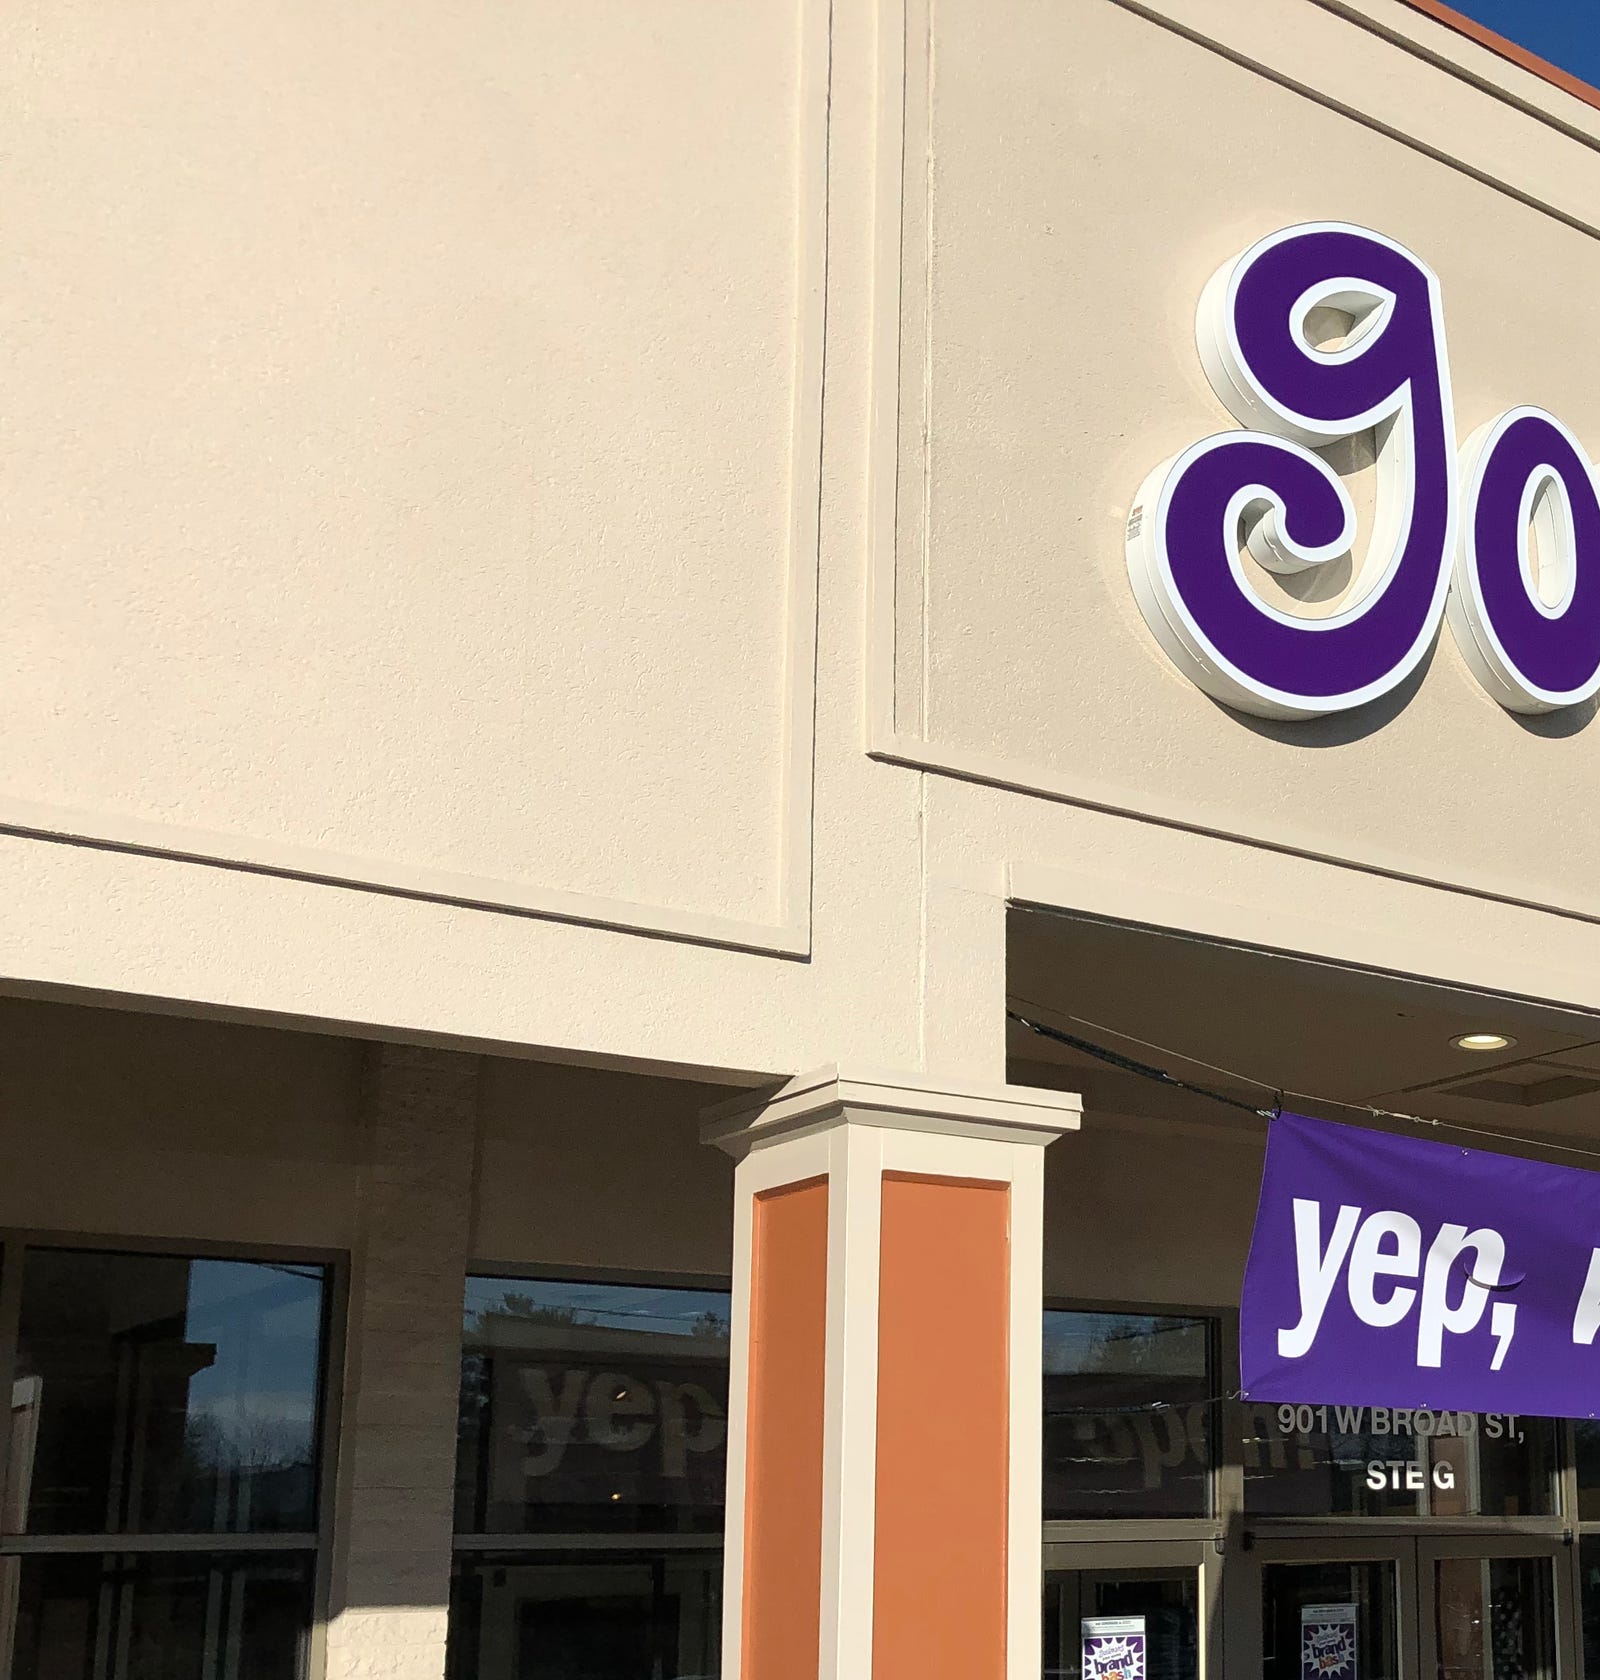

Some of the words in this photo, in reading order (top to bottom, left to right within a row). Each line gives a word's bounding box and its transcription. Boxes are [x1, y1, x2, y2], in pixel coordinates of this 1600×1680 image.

[1277, 1197, 1520, 1372] yep,
[1278, 1404, 1328, 1434] 901
[1335, 1406, 1364, 1435] W
[1371, 1407, 1476, 1437] BROAD
[1485, 1413, 1524, 1444] ST,
[1366, 1460, 1425, 1490] STE
[1432, 1460, 1455, 1490] G
[1093, 1649, 1134, 1675] brand
